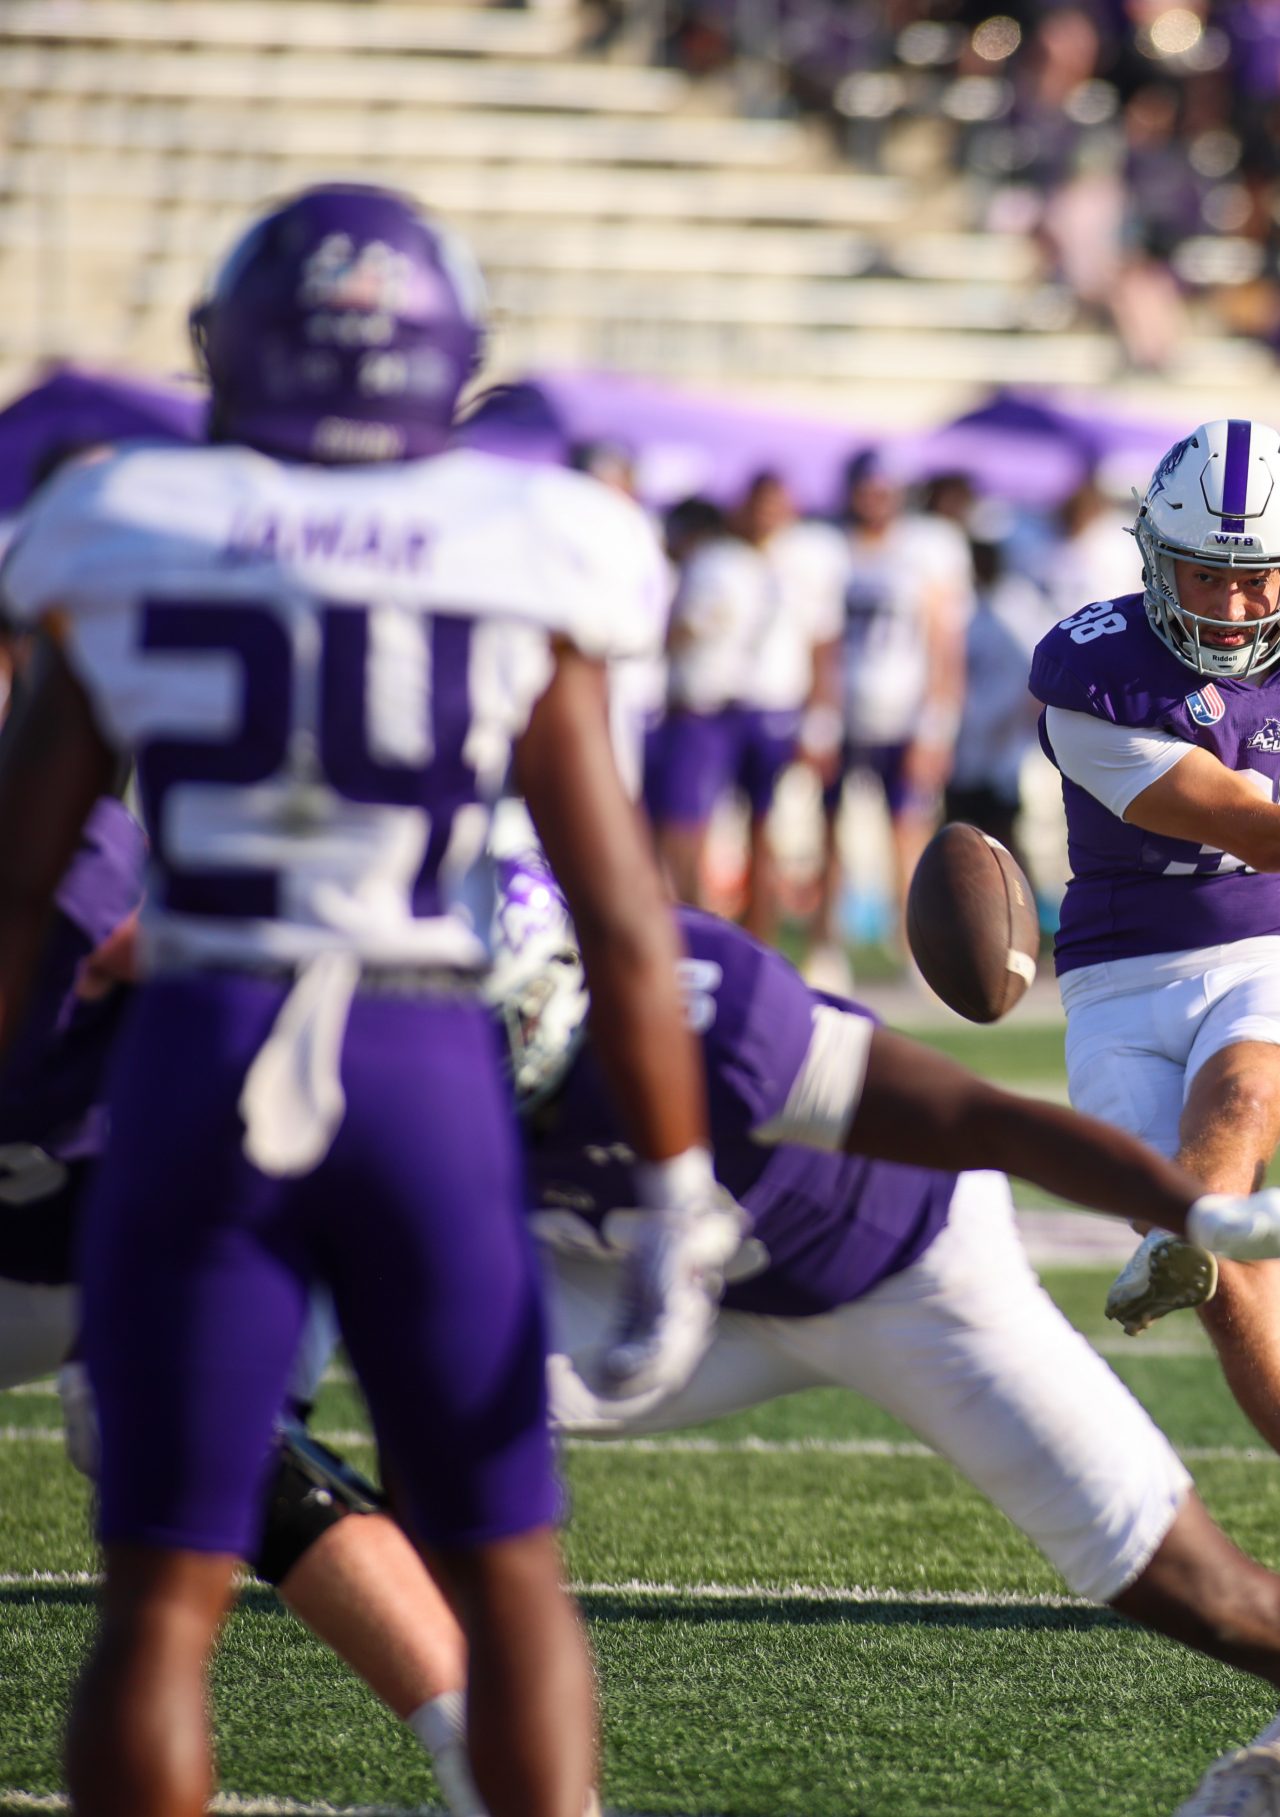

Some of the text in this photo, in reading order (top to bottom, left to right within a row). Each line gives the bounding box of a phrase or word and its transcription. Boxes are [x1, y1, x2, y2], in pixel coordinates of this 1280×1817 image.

[1214, 535, 1254, 546] WTB
[1059, 601, 1128, 644] 38
[1212, 654, 1238, 662] Riddell
[138, 604, 482, 918] 24
